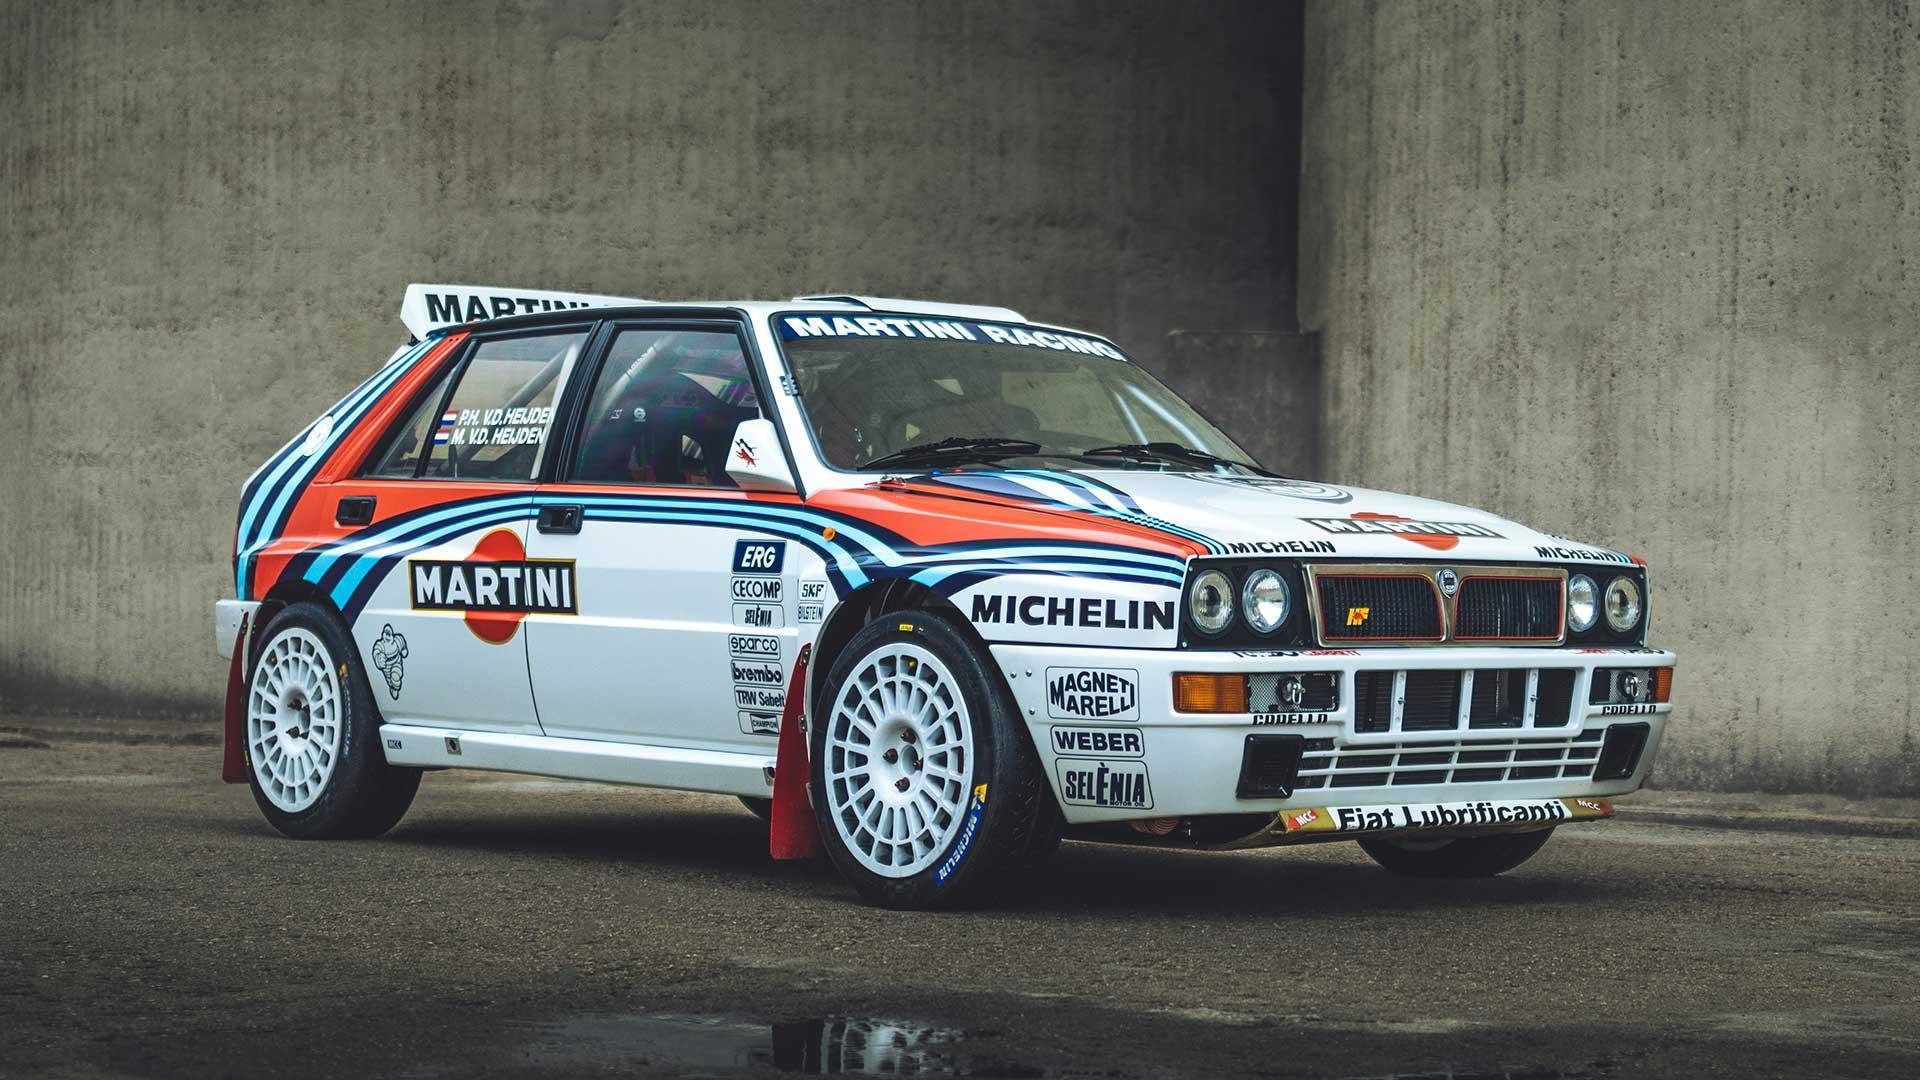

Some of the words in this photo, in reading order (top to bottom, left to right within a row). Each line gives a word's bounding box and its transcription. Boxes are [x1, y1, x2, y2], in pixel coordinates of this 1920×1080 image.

[784, 317, 976, 342] MARTINI
[986, 324, 1127, 362] RACING
[451, 428, 465, 445] M.
[469, 427, 489, 445] V.D.
[491, 427, 547, 445] HEIJDEN
[1308, 519, 1498, 537] MARTINI
[1228, 540, 1336, 554] MICHELIN
[1534, 546, 1618, 562] MICHELIN
[741, 545, 776, 569] ERG
[415, 565, 571, 609] MARTINI
[733, 580, 781, 599] CECOMP
[801, 583, 824, 598] SKF
[971, 594, 1175, 630] MICHELIN
[1346, 607, 1370, 626] HF
[730, 637, 778, 655] sparco
[732, 663, 782, 683] brembo
[1050, 671, 1134, 705] MAGNETI
[736, 690, 757, 706] TRW
[758, 691, 785, 708] Sabelt
[1050, 682, 1135, 717] MARELLI
[1054, 731, 1141, 752] WEBER
[1065, 762, 1145, 805] SELÈNIA
[1577, 800, 1601, 811] MCC
[1295, 810, 1317, 827] MCC
[1336, 806, 1396, 832] Fiat
[1401, 801, 1565, 828] Lubrificanti
[939, 816, 978, 880] MICHELIN
